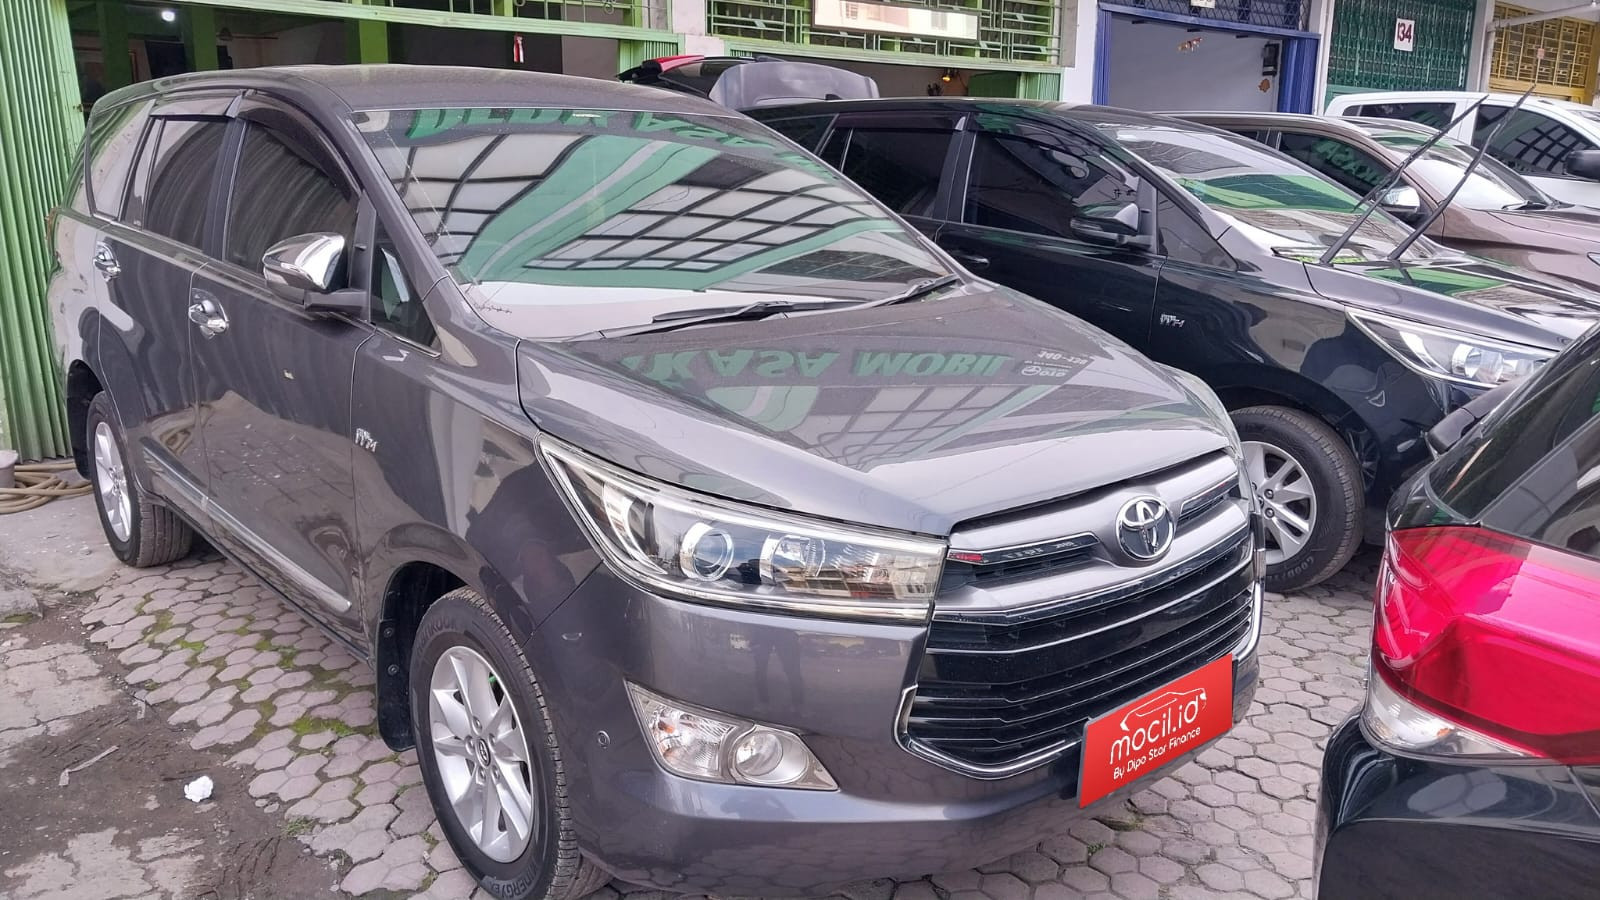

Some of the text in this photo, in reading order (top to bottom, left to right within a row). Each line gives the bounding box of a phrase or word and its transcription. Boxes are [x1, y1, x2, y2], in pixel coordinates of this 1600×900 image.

[1397, 22, 1412, 43] 134
[1110, 695, 1198, 764] mocil.id
[1113, 727, 1200, 780] By Dipo Star Finance
